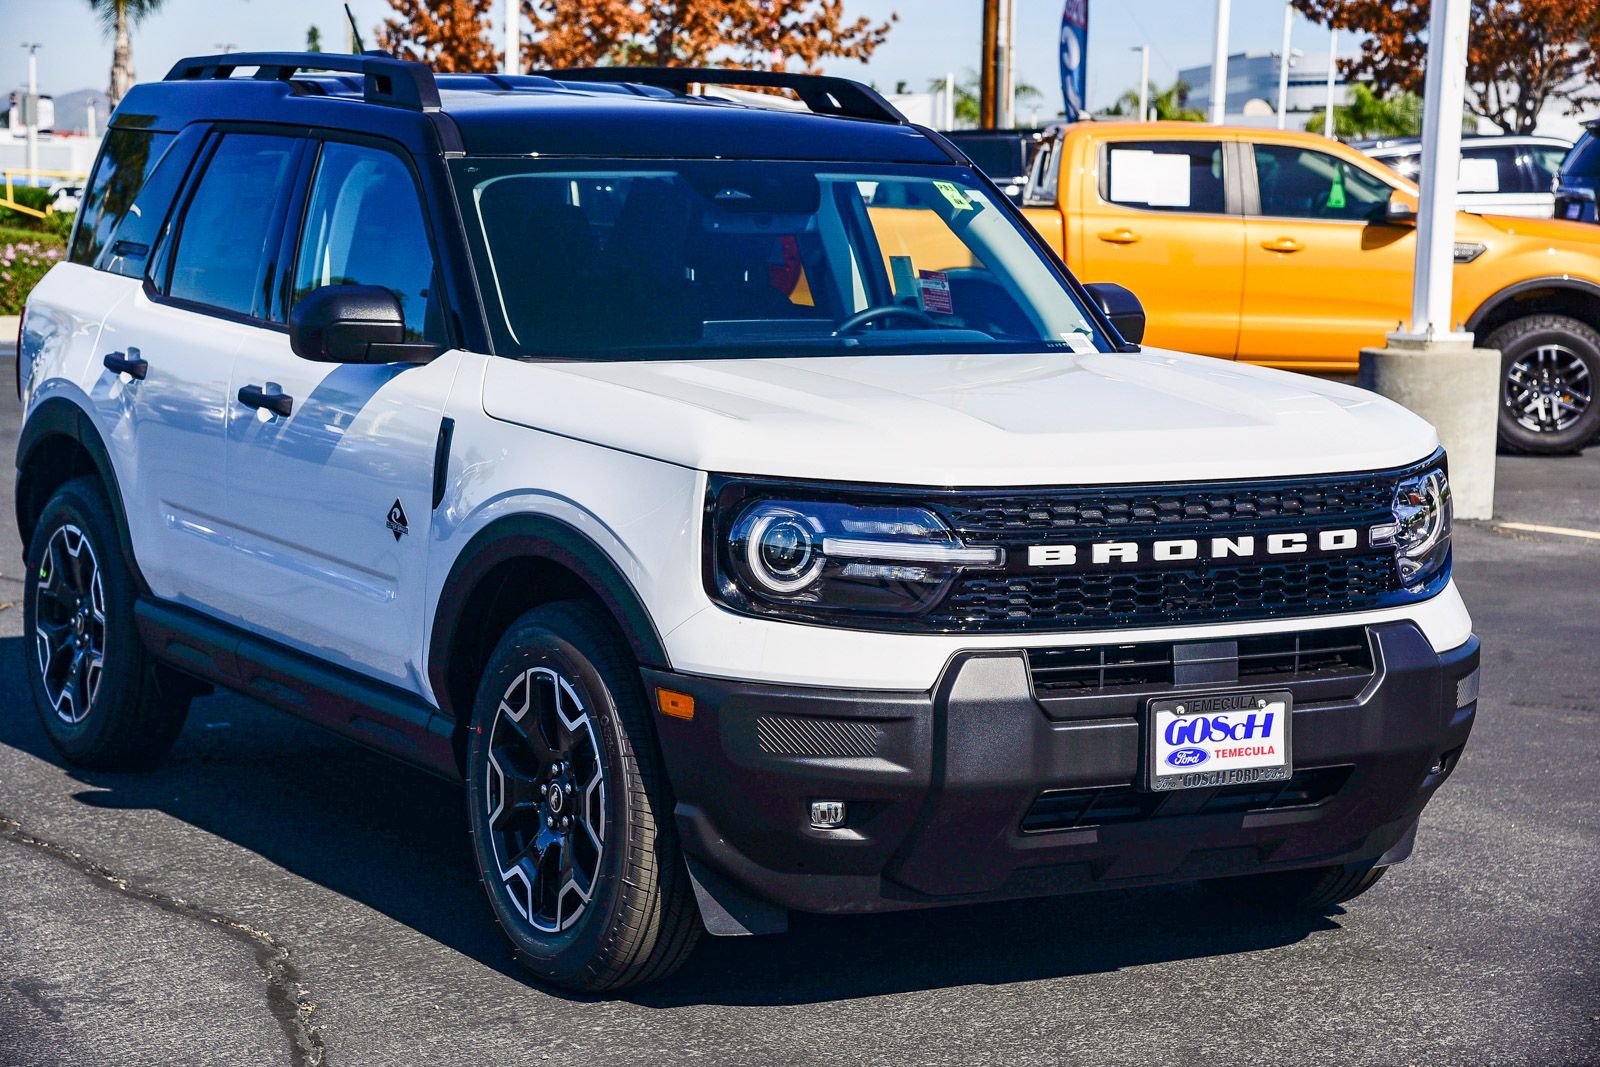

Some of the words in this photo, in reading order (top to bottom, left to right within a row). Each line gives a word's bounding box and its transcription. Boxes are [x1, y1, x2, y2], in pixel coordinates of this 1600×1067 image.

[1028, 529, 1357, 566] BRONCO
[1184, 696, 1257, 713] TEMECULA
[1174, 750, 1200, 764] Ford
[1214, 745, 1275, 759] TEMECULA
[1229, 767, 1260, 784] FORD
